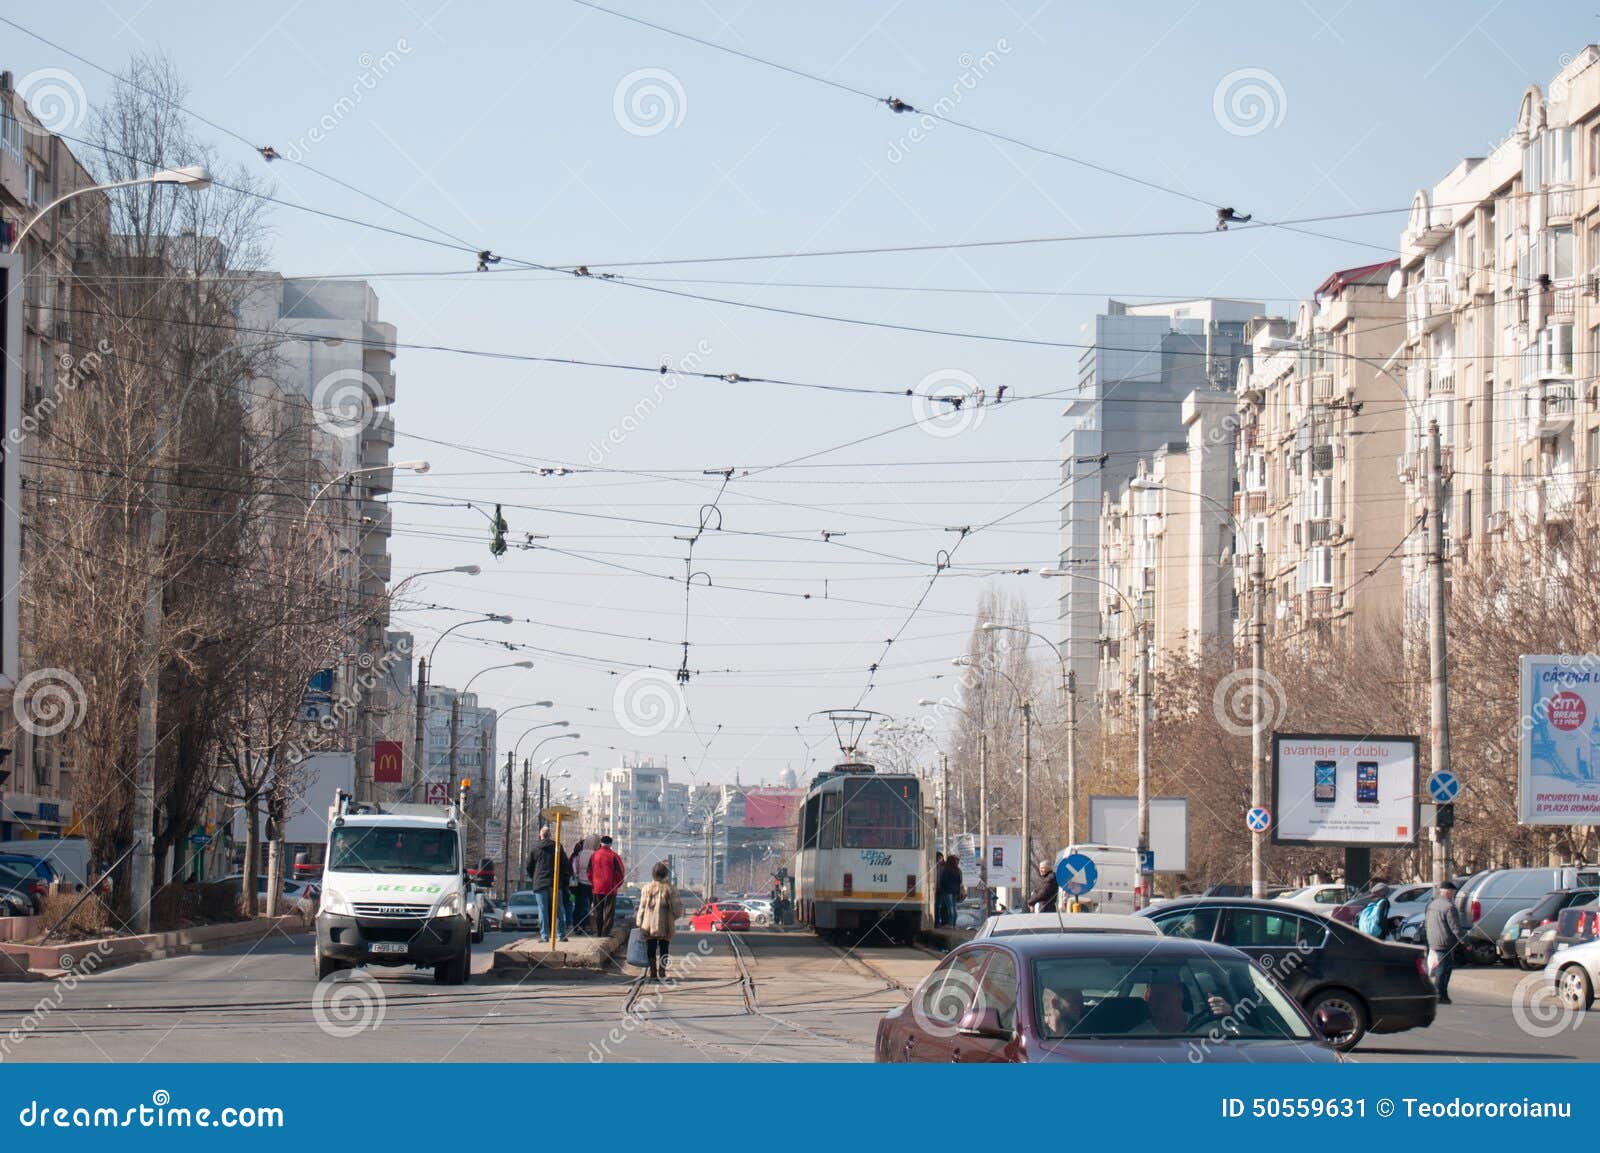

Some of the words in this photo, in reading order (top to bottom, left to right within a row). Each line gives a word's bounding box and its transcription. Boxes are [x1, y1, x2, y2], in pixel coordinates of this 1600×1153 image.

[1552, 699, 1580, 710] CITY
[1284, 745, 1336, 758] avantaje
[1340, 745, 1350, 756] la
[1354, 745, 1389, 756] dublu
[1543, 804, 1569, 812] PLAZA
